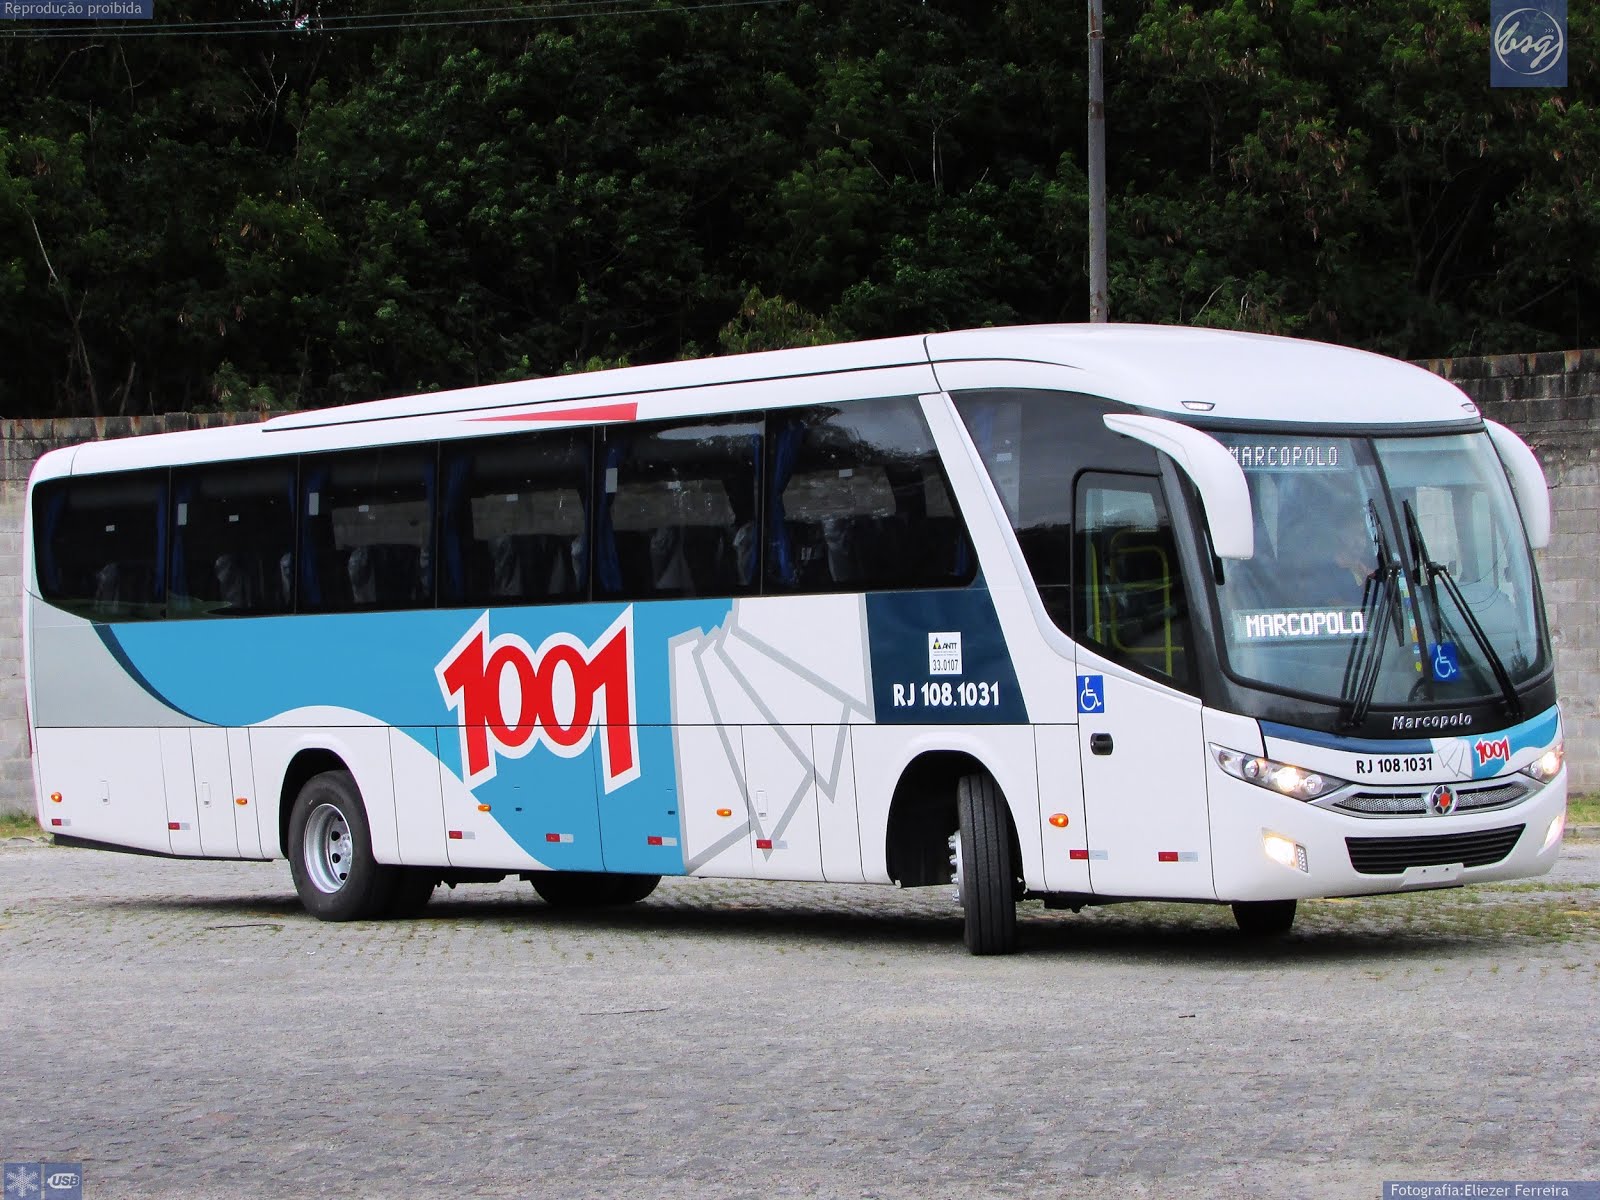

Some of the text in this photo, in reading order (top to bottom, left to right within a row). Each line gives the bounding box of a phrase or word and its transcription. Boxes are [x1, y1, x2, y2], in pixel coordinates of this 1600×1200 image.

[1228, 446, 1338, 466] MARCOPOLO
[1245, 611, 1364, 638] MARCOPOLO
[932, 659, 959, 671] 33.0107
[435, 605, 640, 793] 1001
[893, 681, 999, 707] RJ 108.1031
[1392, 712, 1472, 730] Marcopolo
[1475, 736, 1509, 765] 1001
[1356, 757, 1433, 774] RJ 108.1031
